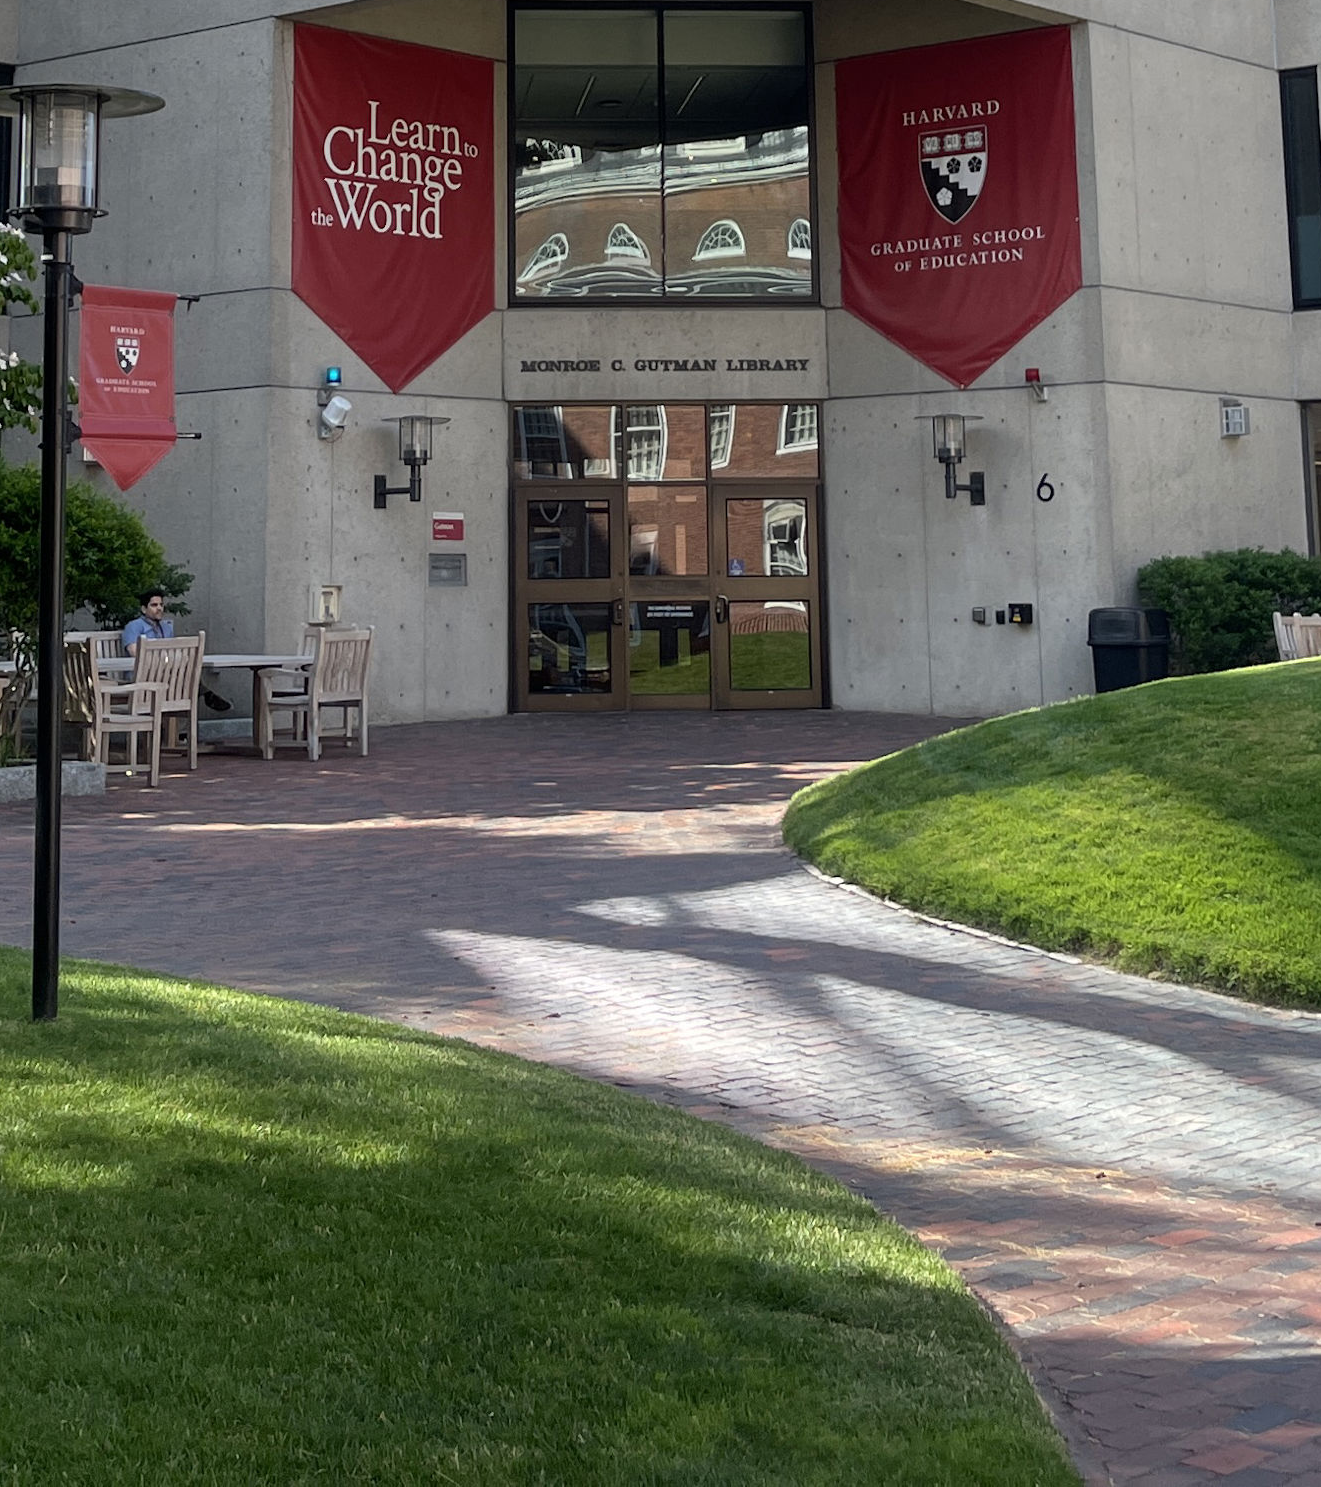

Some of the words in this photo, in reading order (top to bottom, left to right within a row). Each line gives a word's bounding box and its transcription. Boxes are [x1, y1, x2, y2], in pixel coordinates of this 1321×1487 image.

[902, 100, 1001, 127] HARVARD
[367, 100, 463, 156] Learn
[464, 142, 479, 158] to
[323, 126, 463, 202] Change
[311, 207, 334, 227] the
[324, 177, 443, 239] World
[870, 234, 963, 257] GRADUATE
[972, 226, 1046, 246] SCHOOL
[894, 260, 912, 273] OF
[920, 248, 1024, 271] EDUCATION
[110, 325, 145, 335] HARVARD
[520, 359, 601, 373] MONROE
[610, 359, 626, 373] C.
[634, 359, 718, 372] GUTMAN
[725, 358, 810, 372] LIBRARY
[95, 377, 130, 385] GRADUATE
[131, 379, 157, 388] SCHOOL
[1036, 473, 1055, 502] 6
